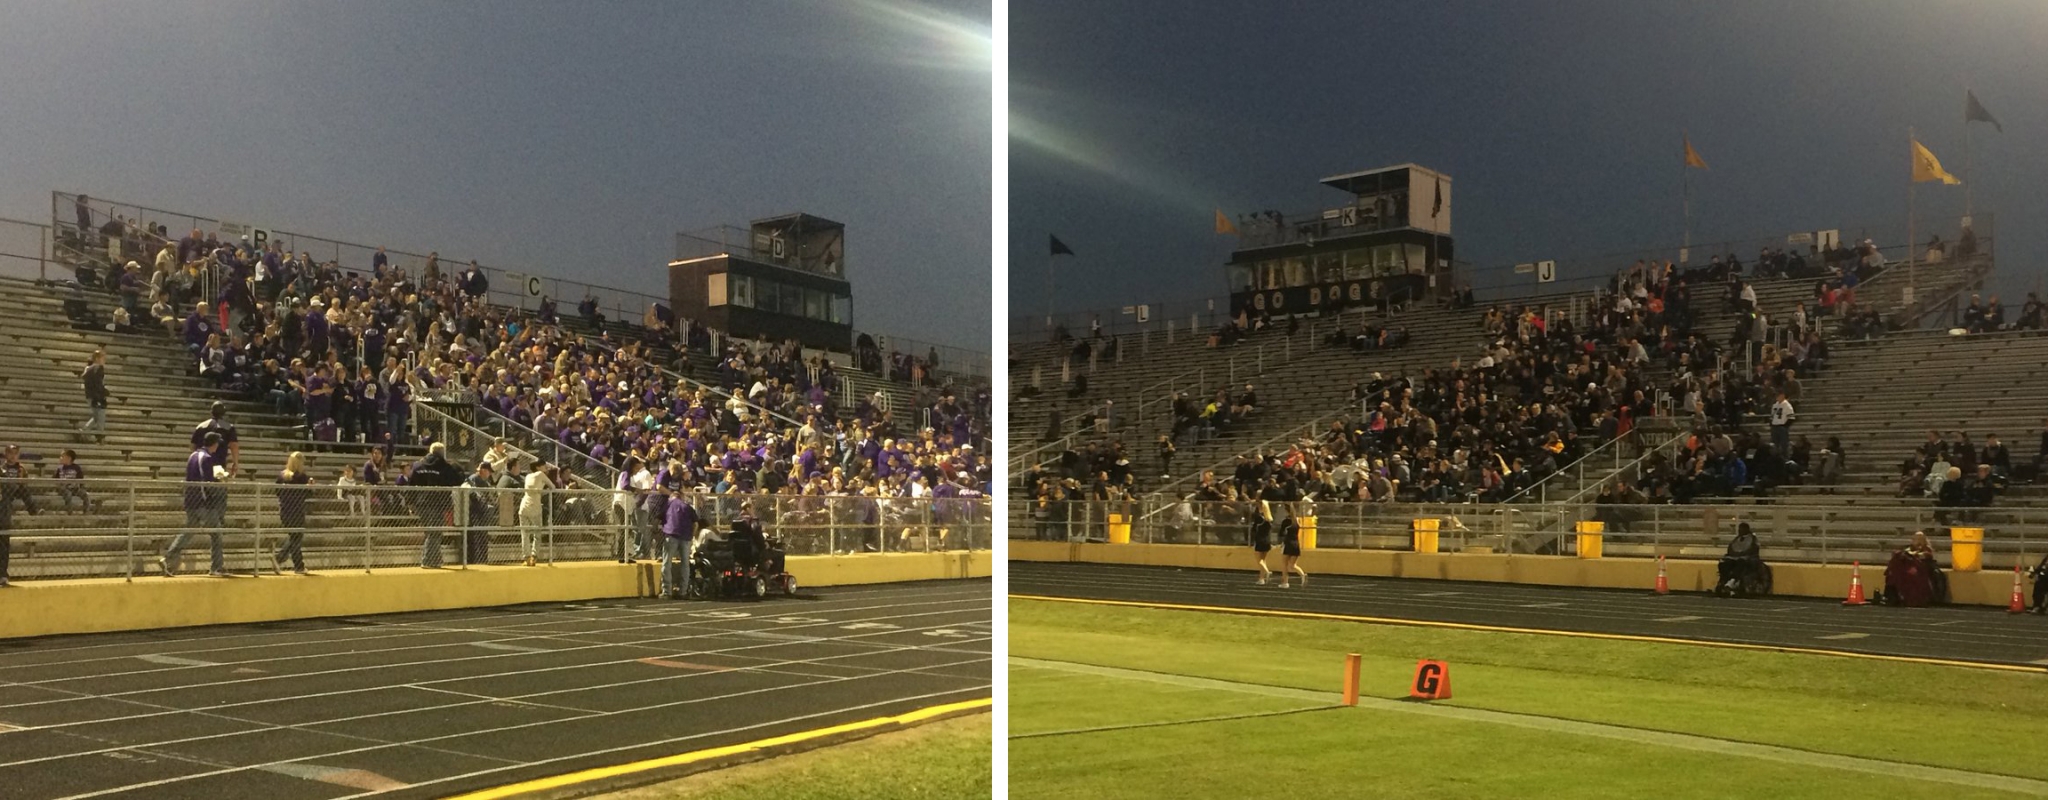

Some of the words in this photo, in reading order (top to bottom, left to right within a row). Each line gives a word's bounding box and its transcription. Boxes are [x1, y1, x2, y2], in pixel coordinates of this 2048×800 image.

[1343, 209, 1354, 224] K
[774, 239, 783, 256] D
[1542, 262, 1551, 281] J
[528, 277, 541, 297] C
[1253, 291, 1284, 310] GO
[1139, 306, 1147, 321] L
[879, 336, 885, 350] E
[1416, 663, 1442, 695] G
